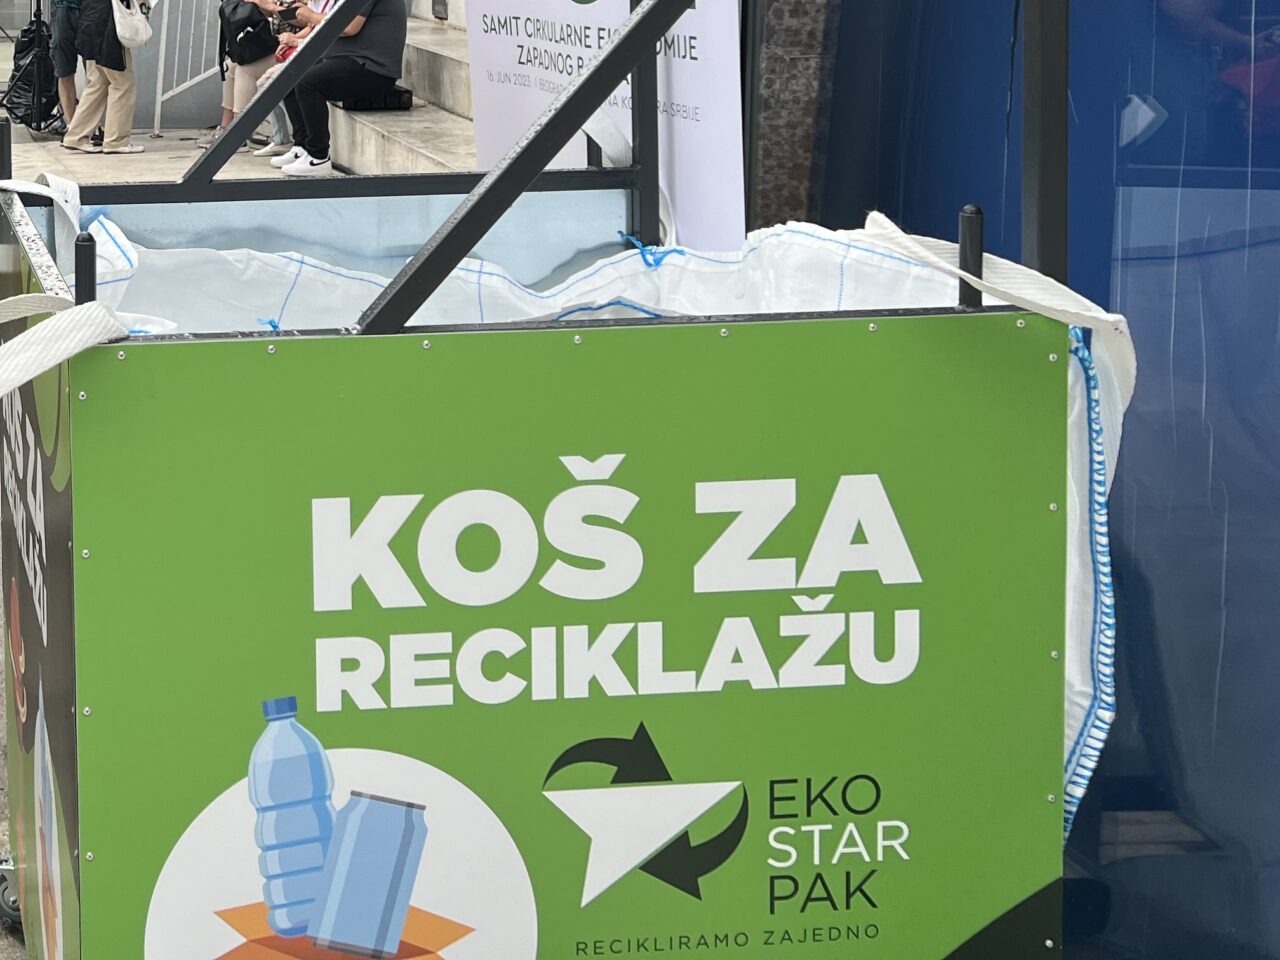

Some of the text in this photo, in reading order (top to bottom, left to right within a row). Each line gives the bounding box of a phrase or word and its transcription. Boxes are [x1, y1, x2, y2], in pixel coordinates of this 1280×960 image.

[482, 14, 698, 61] SAMIT CIRKULARNE EOMIJE
[517, 44, 573, 76] ZAPADNOG
[497, 71, 511, 83] JUN
[670, 102, 701, 122] SRBIJE
[312, 453, 923, 612] KOŠ ZA
[315, 593, 920, 713] RECIKLAŽU
[769, 774, 882, 820] EKO
[767, 820, 910, 868] STAR
[769, 869, 879, 915] PAK
[576, 923, 879, 956] RECIKLIRAMO ZAJEDNO
